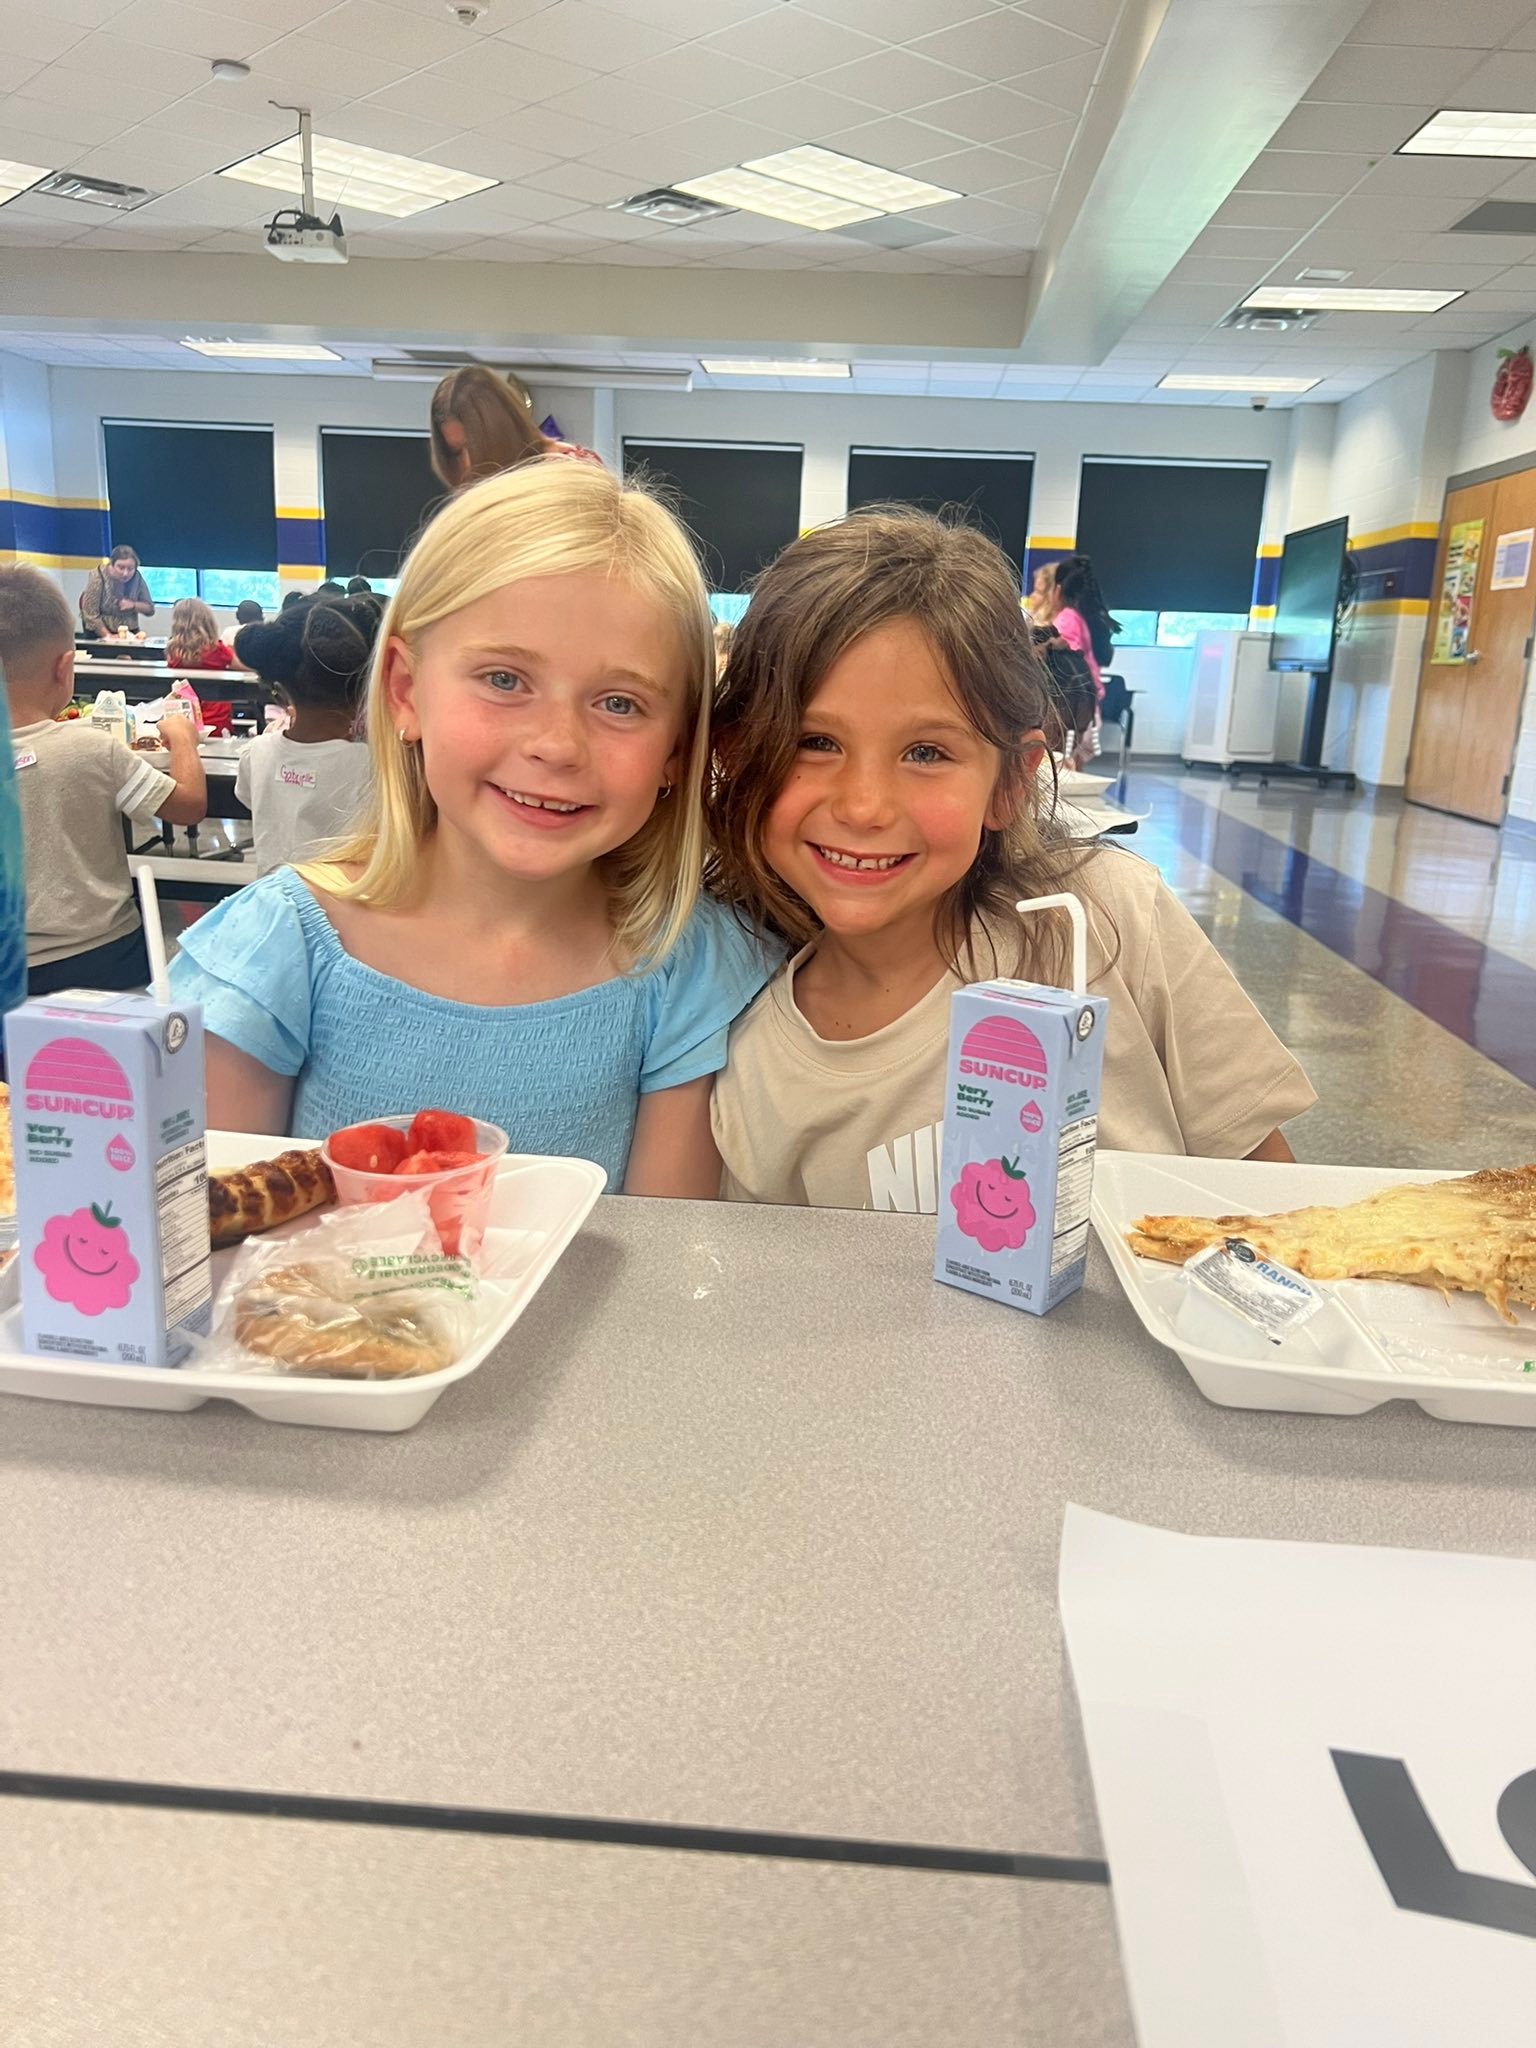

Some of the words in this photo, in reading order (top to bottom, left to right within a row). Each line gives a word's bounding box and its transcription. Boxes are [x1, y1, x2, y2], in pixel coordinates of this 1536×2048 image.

[959, 1060, 1047, 1089] SUNCUP
[957, 1083, 988, 1098] Very
[25, 1093, 135, 1120] SUNCUP
[957, 1092, 994, 1108] Berry
[26, 1122, 65, 1137] Very
[27, 1133, 74, 1148] Berry
[866, 1119, 944, 1213] NI
